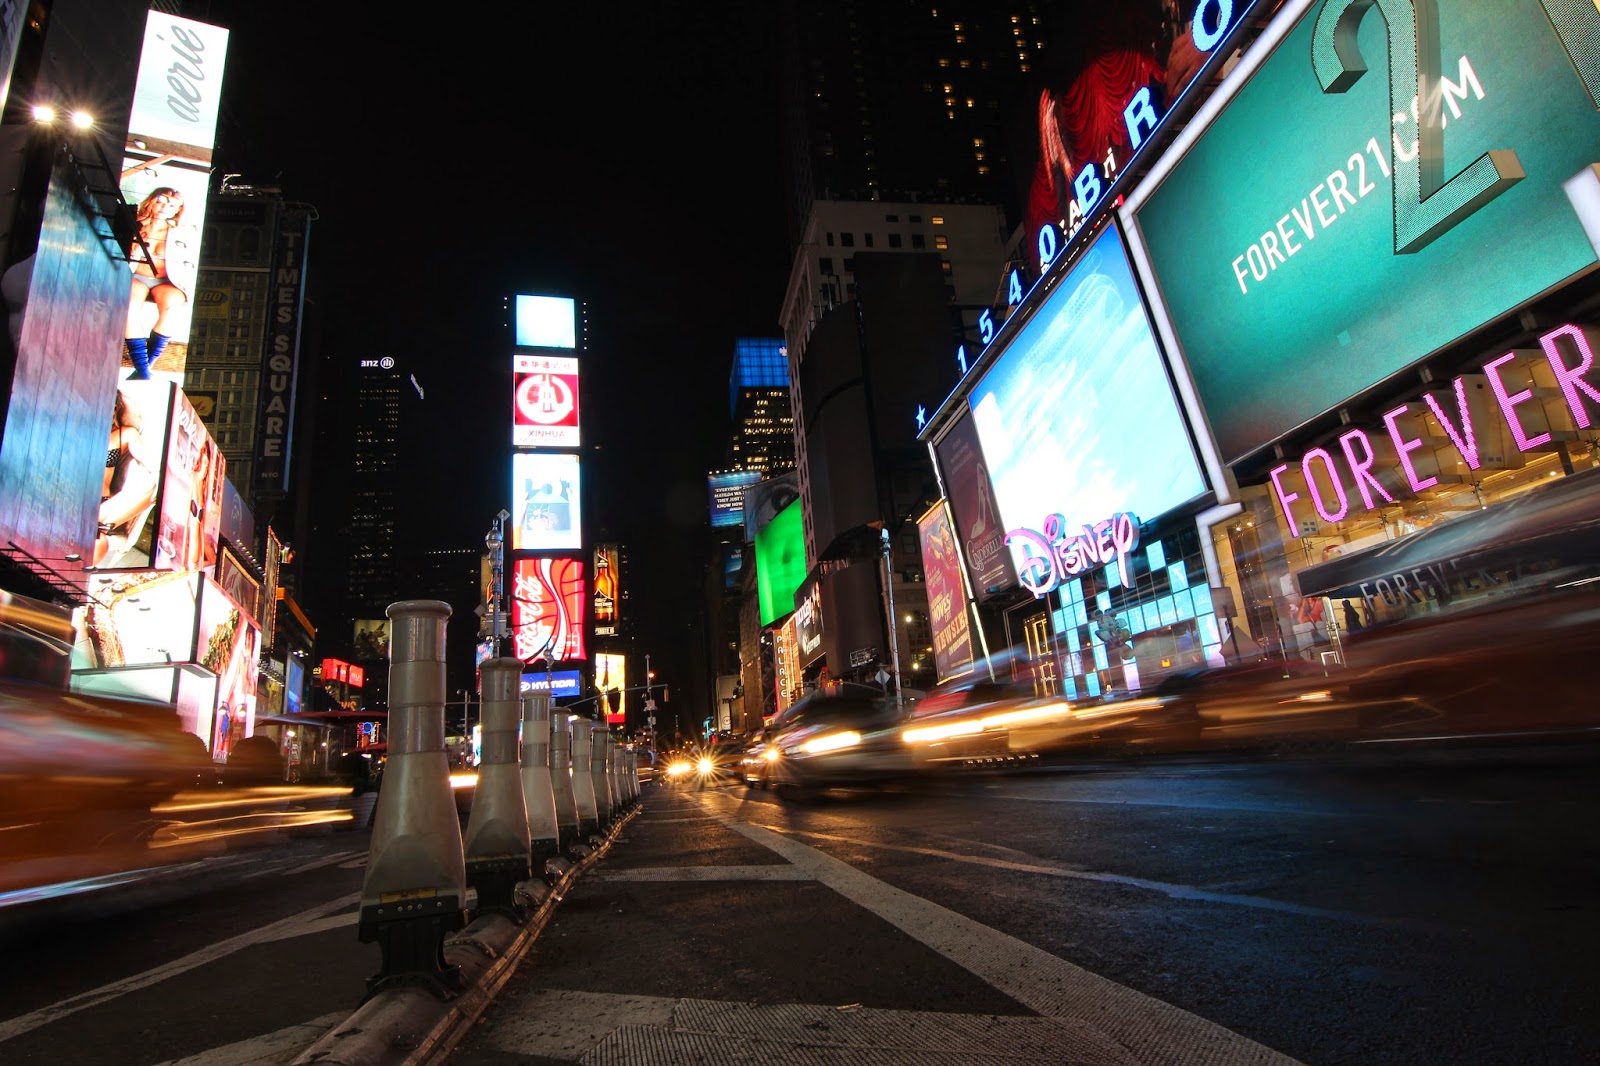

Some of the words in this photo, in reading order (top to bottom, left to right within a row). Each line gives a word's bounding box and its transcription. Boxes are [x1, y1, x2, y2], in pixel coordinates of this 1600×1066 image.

[156, 24, 206, 123] aerie
[1232, 55, 1486, 295] FOREVER21CM
[276, 232, 302, 324] TIMES
[263, 334, 292, 458] SQUARE
[360, 359, 379, 367] anz
[528, 429, 565, 438] XINHUA
[1269, 323, 1600, 539] FOREVER
[531, 678, 576, 690] HYUNDAI
[777, 635, 788, 698] PALACE
